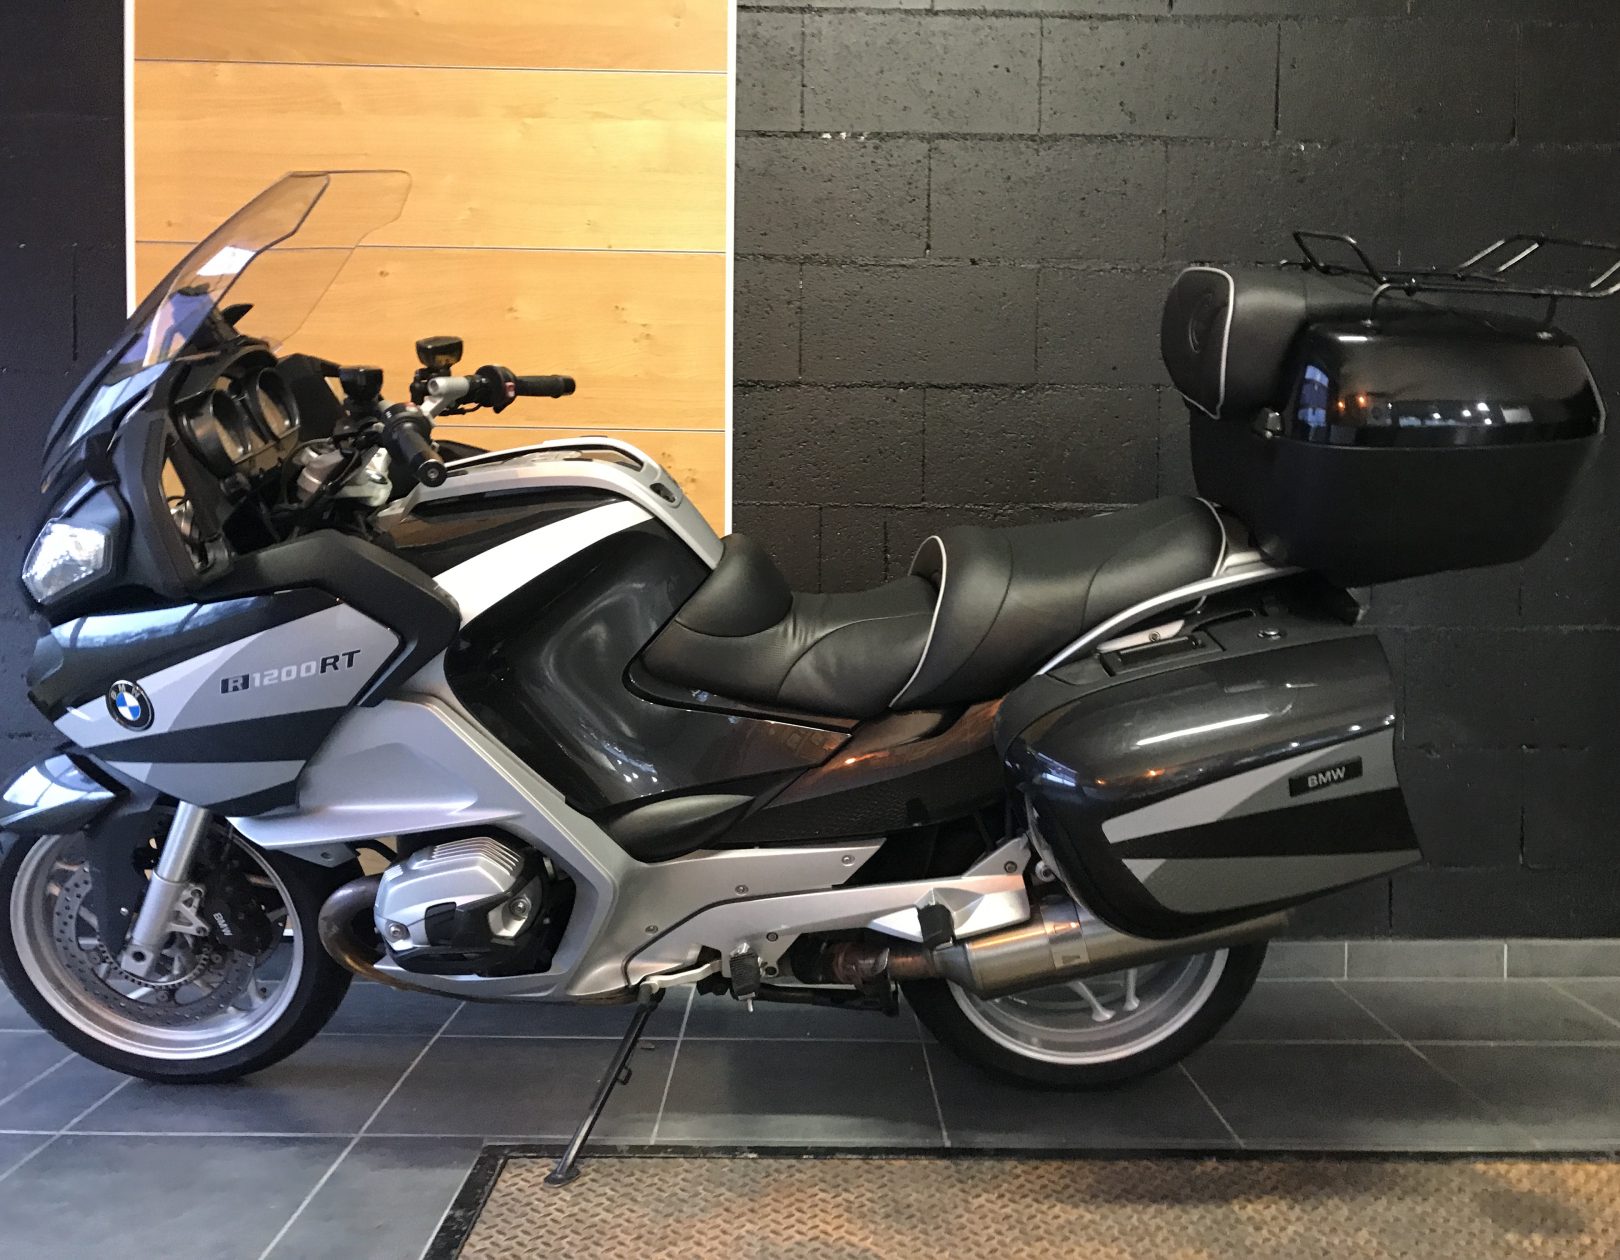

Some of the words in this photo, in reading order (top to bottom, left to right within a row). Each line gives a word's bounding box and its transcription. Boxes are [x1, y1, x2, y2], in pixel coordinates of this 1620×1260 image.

[110, 682, 141, 700] BMW
[1307, 766, 1346, 788] BMW
[212, 912, 233, 936] BMW
